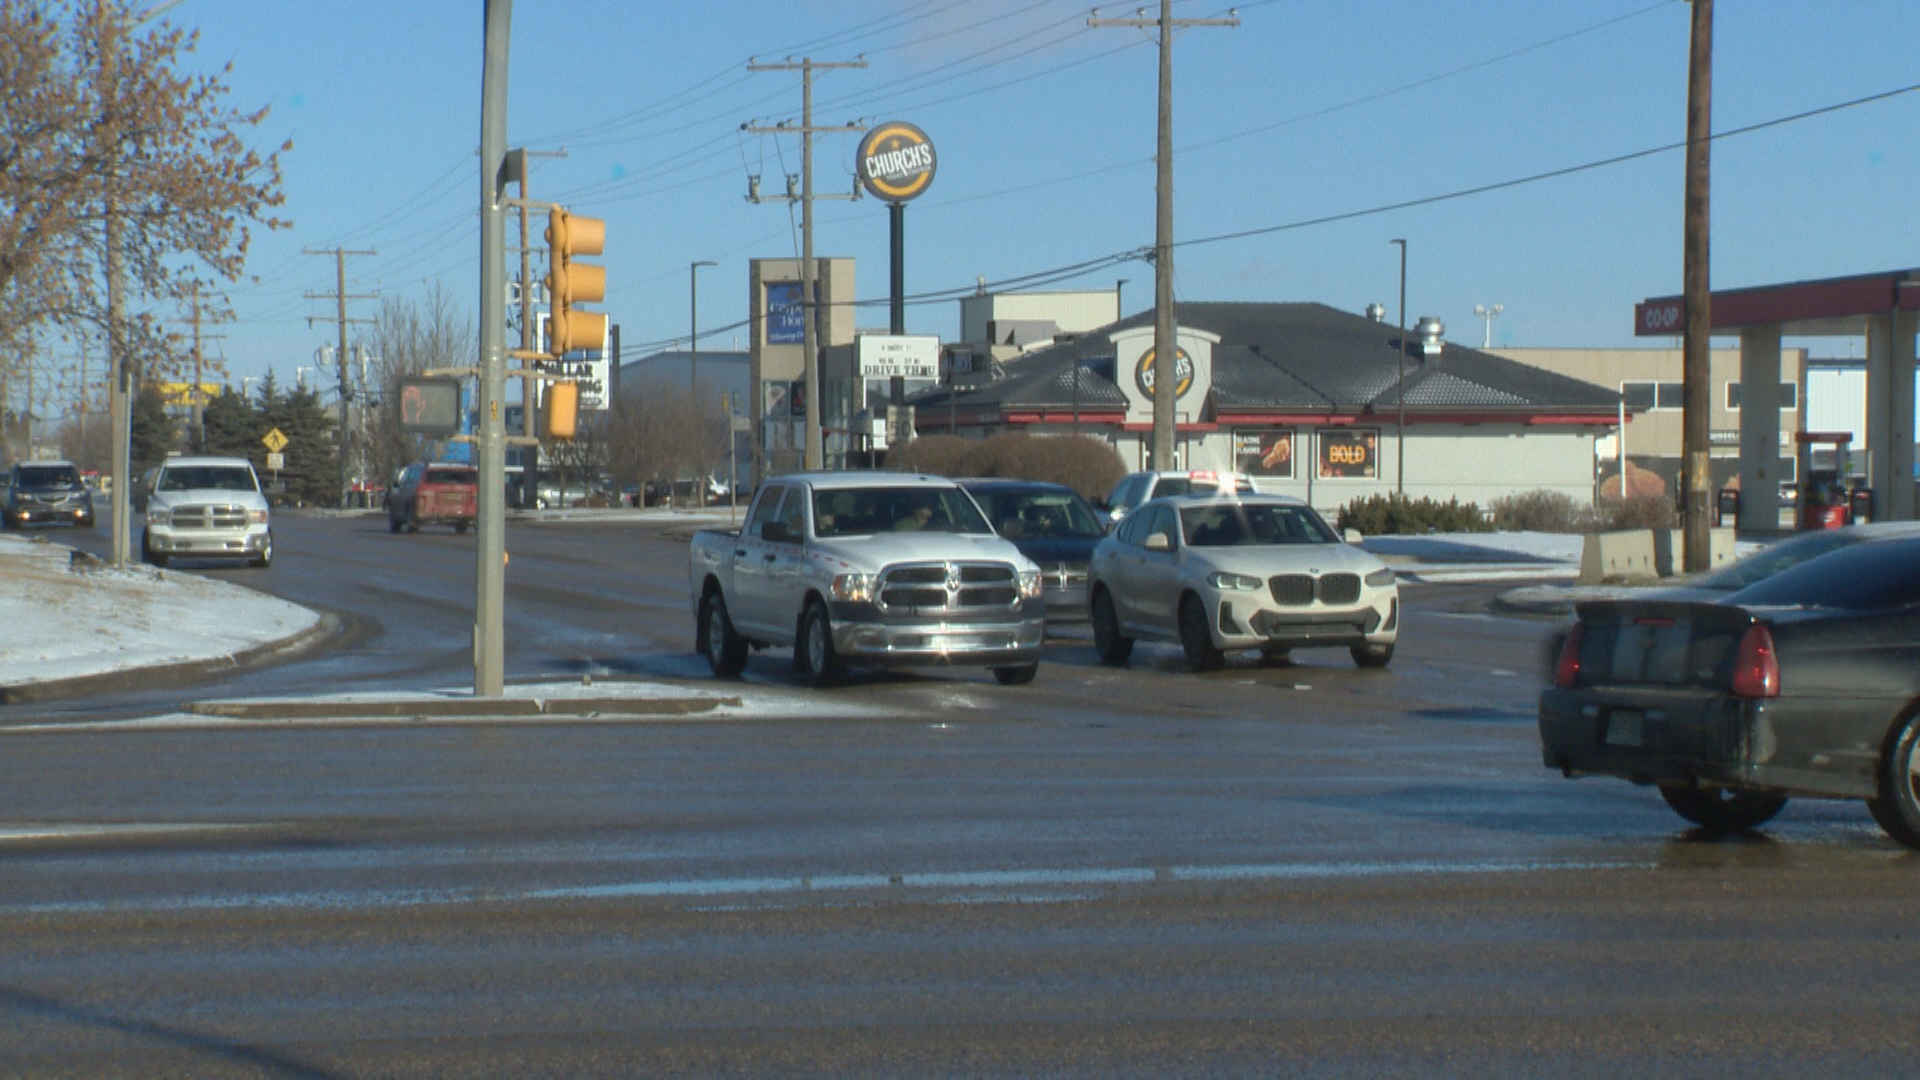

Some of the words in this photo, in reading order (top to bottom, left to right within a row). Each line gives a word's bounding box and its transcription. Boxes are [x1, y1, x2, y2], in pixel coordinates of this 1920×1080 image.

[865, 143, 932, 179] CHURCH'S
[1646, 307, 1678, 328] CO-OP
[864, 365, 901, 376] DRIVE
[904, 365, 936, 376] THRU
[890, 420, 912, 438] 50
[1329, 445, 1365, 464] BOLD
